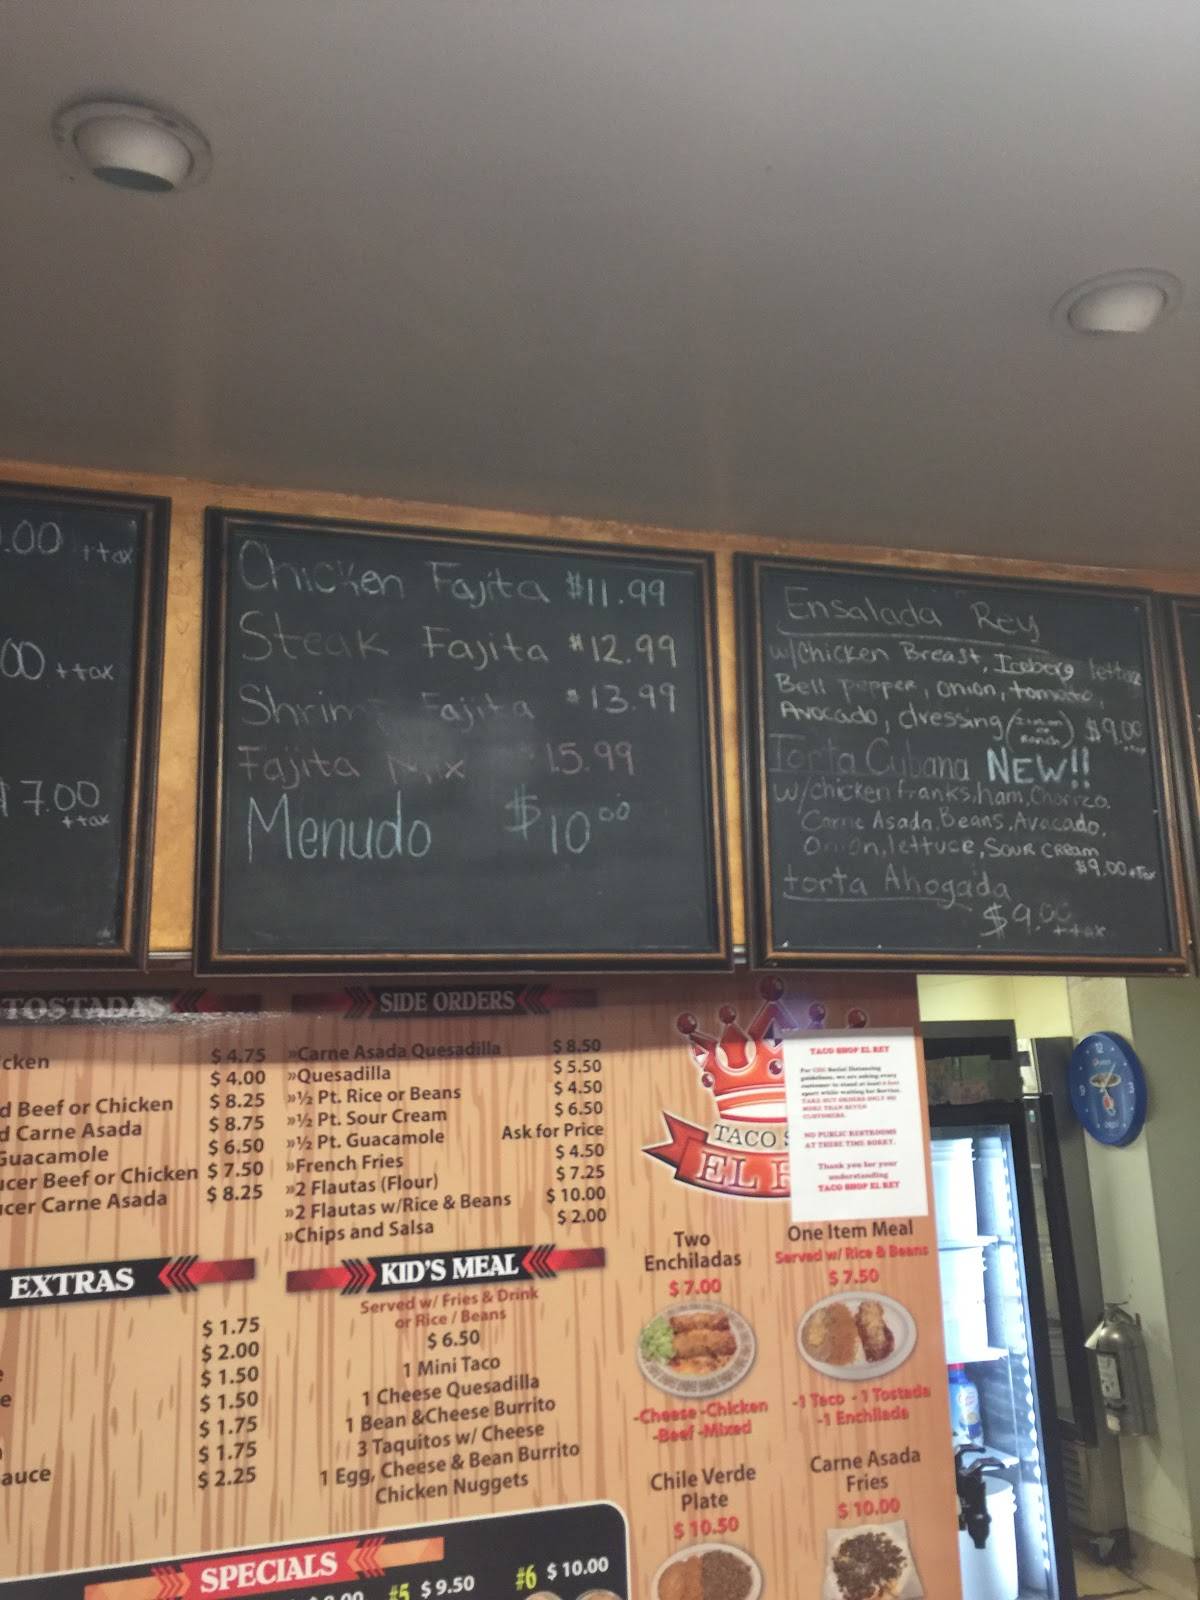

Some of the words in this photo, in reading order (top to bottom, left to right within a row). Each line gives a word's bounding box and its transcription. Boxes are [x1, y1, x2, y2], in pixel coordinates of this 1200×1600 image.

[239, 540, 403, 593] Chicken
[430, 561, 550, 608] Fajita
[566, 571, 665, 608] $11.99
[784, 586, 942, 627] Ensalada
[970, 601, 1040, 643] Rey
[240, 611, 389, 661] Steak
[423, 625, 549, 671] Fajita
[774, 672, 826, 695] Bell
[239, 746, 359, 789] Fajita
[768, 732, 856, 774] Torta
[986, 746, 1090, 789] NEW!!
[249, 790, 432, 862] Menudo
[885, 862, 1011, 909] Ahogada
[980, 902, 1072, 938] $9.00
[2, 996, 165, 1020] TOSTADAS
[381, 993, 428, 1012] SIDE
[433, 991, 515, 1011] ORDERS
[298, 1045, 349, 1063] Carne
[354, 1044, 406, 1060] Asada
[412, 1040, 501, 1060] Quesadilla
[297, 1065, 391, 1084] Quesadilla
[18, 1100, 64, 1117] Beef
[69, 1103, 90, 1115] or
[96, 1097, 173, 1115] Chicken
[318, 1090, 342, 1104] Pt.
[347, 1088, 382, 1103] Rice
[387, 1090, 405, 1101] or
[410, 1087, 461, 1100] Beans
[318, 1113, 342, 1126] Pt.
[347, 1110, 387, 1125] Sour
[391, 1108, 447, 1123] Cream
[17, 1125, 75, 1141] Carne
[82, 1121, 142, 1138] Asada
[317, 1134, 341, 1149] Pt.
[347, 1130, 445, 1148] Guacamole
[502, 1125, 532, 1140] Ask
[536, 1124, 559, 1138] for
[564, 1122, 604, 1137] Price
[714, 1124, 776, 1148] TACO
[296, 1158, 357, 1174] French
[362, 1154, 404, 1170] Fries
[695, 1152, 758, 1190] EL
[43, 1170, 90, 1188] Beef
[95, 1173, 115, 1185] or
[121, 1165, 199, 1184] Chicken
[295, 1182, 305, 1196] 2
[312, 1179, 376, 1195] Flautas
[381, 1174, 438, 1193] (Flour)
[42, 1197, 102, 1213] Carne
[108, 1191, 167, 1209] Asada
[295, 1206, 305, 1219] 2
[311, 1202, 376, 1218] Flautas
[443, 1196, 455, 1209] &
[461, 1194, 511, 1209] Beans
[295, 1226, 346, 1245] Chips
[350, 1222, 384, 1238] and
[389, 1221, 434, 1237] Salsa
[674, 1231, 710, 1248] Two
[788, 1225, 823, 1242] One
[828, 1222, 867, 1240] Item
[872, 1219, 913, 1237] Meal
[452, 1254, 519, 1279] MEAL
[644, 1251, 741, 1271] Enchiladas
[775, 1248, 822, 1265] Served
[10, 1267, 135, 1300] EXTRAS
[361, 1296, 415, 1314] Served
[443, 1292, 478, 1307] Fries
[482, 1291, 493, 1303] &
[498, 1287, 538, 1302] Drink
[395, 1316, 411, 1329] or
[415, 1312, 447, 1328] Rice
[462, 1308, 506, 1324] Beans
[404, 1363, 411, 1377] 1
[418, 1359, 457, 1376] Mini
[463, 1356, 500, 1372] Taco
[363, 1392, 370, 1406] 1
[378, 1387, 441, 1405] Cheese
[447, 1375, 539, 1398] Quesadilla
[346, 1417, 354, 1432] 1
[361, 1414, 406, 1432] Bean
[495, 1397, 555, 1416] Burrito
[358, 1441, 367, 1457] 3
[373, 1431, 450, 1457] Taquitos
[482, 1423, 544, 1443] Cheese
[320, 1471, 328, 1486] 1
[336, 1467, 375, 1488] Egg,
[381, 1458, 445, 1479] Cheese
[451, 1455, 464, 1471] &
[469, 1450, 513, 1468] Bean
[519, 1442, 580, 1463] Burrito
[811, 1455, 862, 1473] Carne
[867, 1448, 921, 1467] Asada
[376, 1484, 447, 1504] Chicken
[454, 1473, 528, 1495] Nuggets
[651, 1470, 698, 1491] Chile
[703, 1465, 757, 1487] Verde
[847, 1474, 888, 1493] Fries
[682, 1492, 728, 1512] Plate
[200, 1551, 338, 1593] SPECIALS
[515, 1565, 536, 1590] #6
